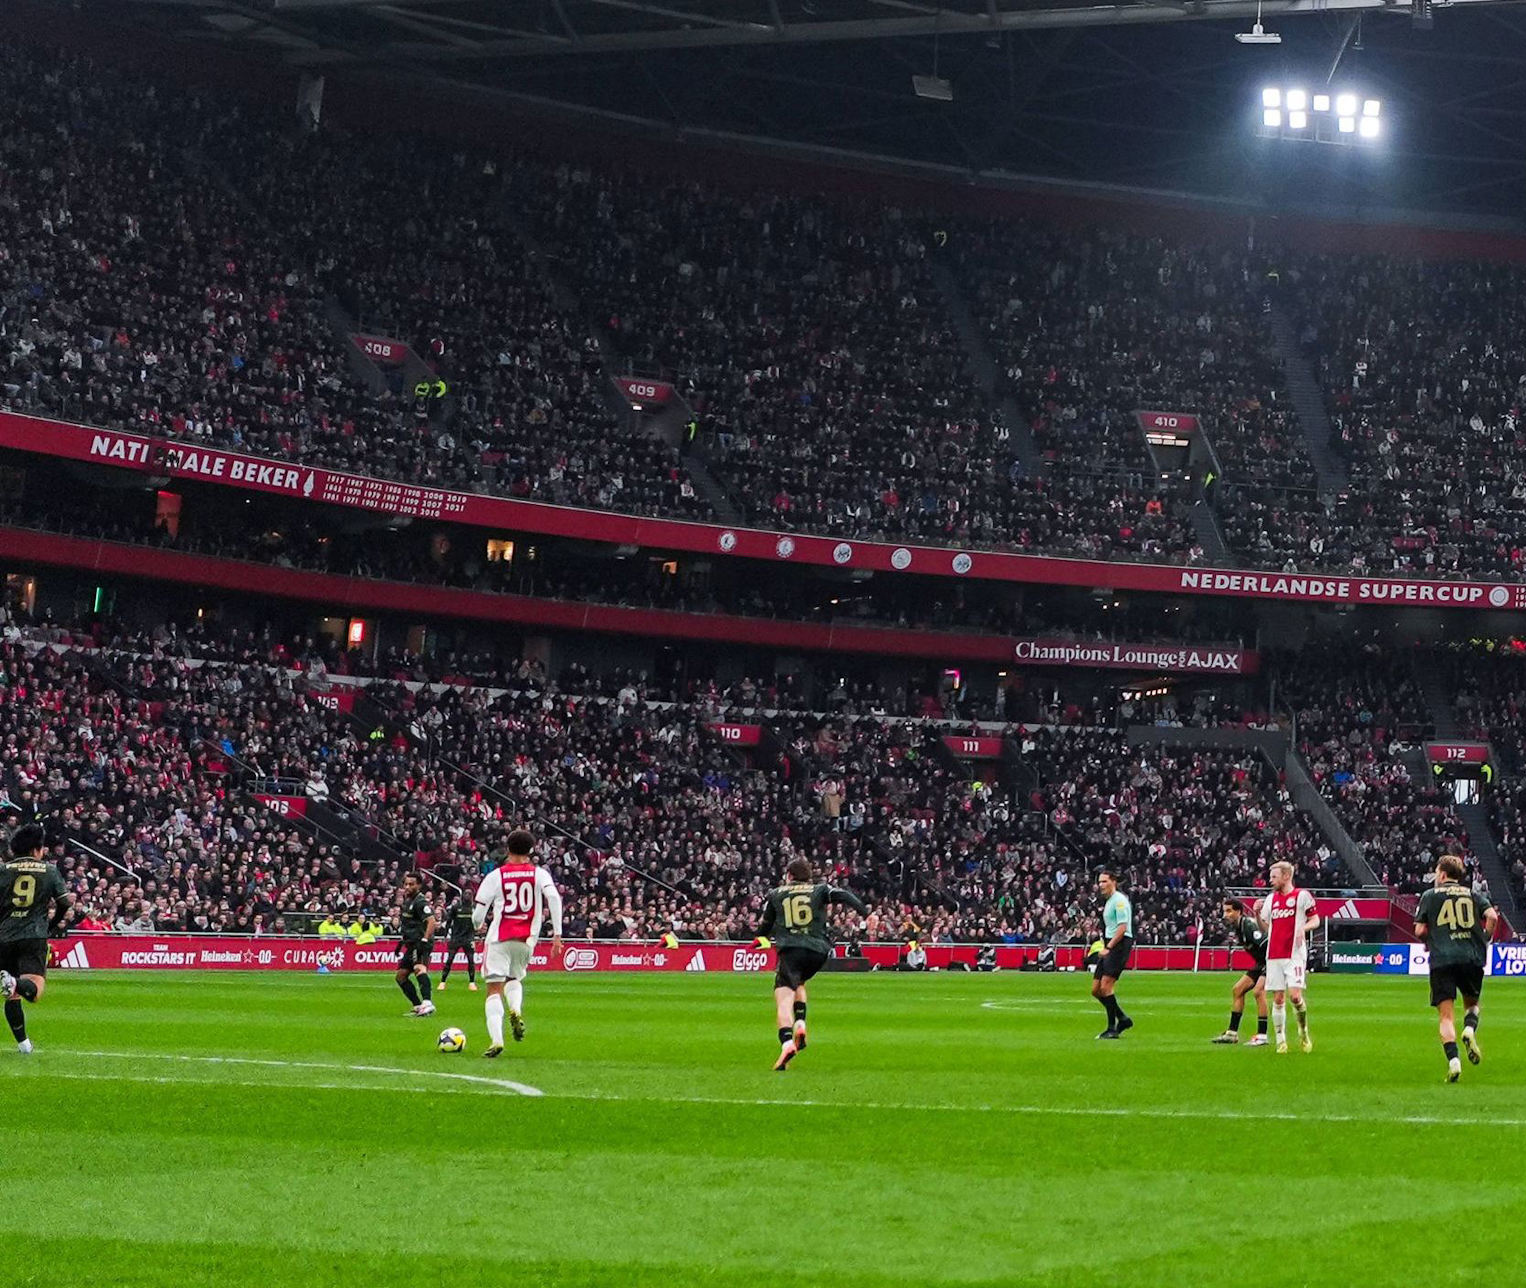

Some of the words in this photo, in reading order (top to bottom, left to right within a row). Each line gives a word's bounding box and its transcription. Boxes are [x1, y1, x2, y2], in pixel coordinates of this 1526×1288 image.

[629, 383, 655, 397] 409
[1154, 416, 1177, 427] 410
[90, 435, 226, 477] NATINALE
[230, 460, 300, 490] BEKER
[1181, 572, 1349, 598] NEDERLANDSE
[1359, 583, 1484, 602] SUPERCUP
[1015, 642, 1110, 663] Champions
[1112, 646, 1179, 669] Lounge
[1187, 652, 1239, 670] AJAX
[721, 727, 740, 739] 110
[963, 741, 979, 751] 111
[1447, 748, 1466, 758] 112
[12, 874, 36, 907] 9
[504, 882, 533, 913] 30
[782, 895, 813, 928] 16
[1437, 897, 1475, 930] 40
[121, 952, 184, 964] ROCKSTARS
[185, 952, 196, 964] IT
[201, 951, 242, 962] Heineken
[1332, 954, 1373, 964] Heineken
